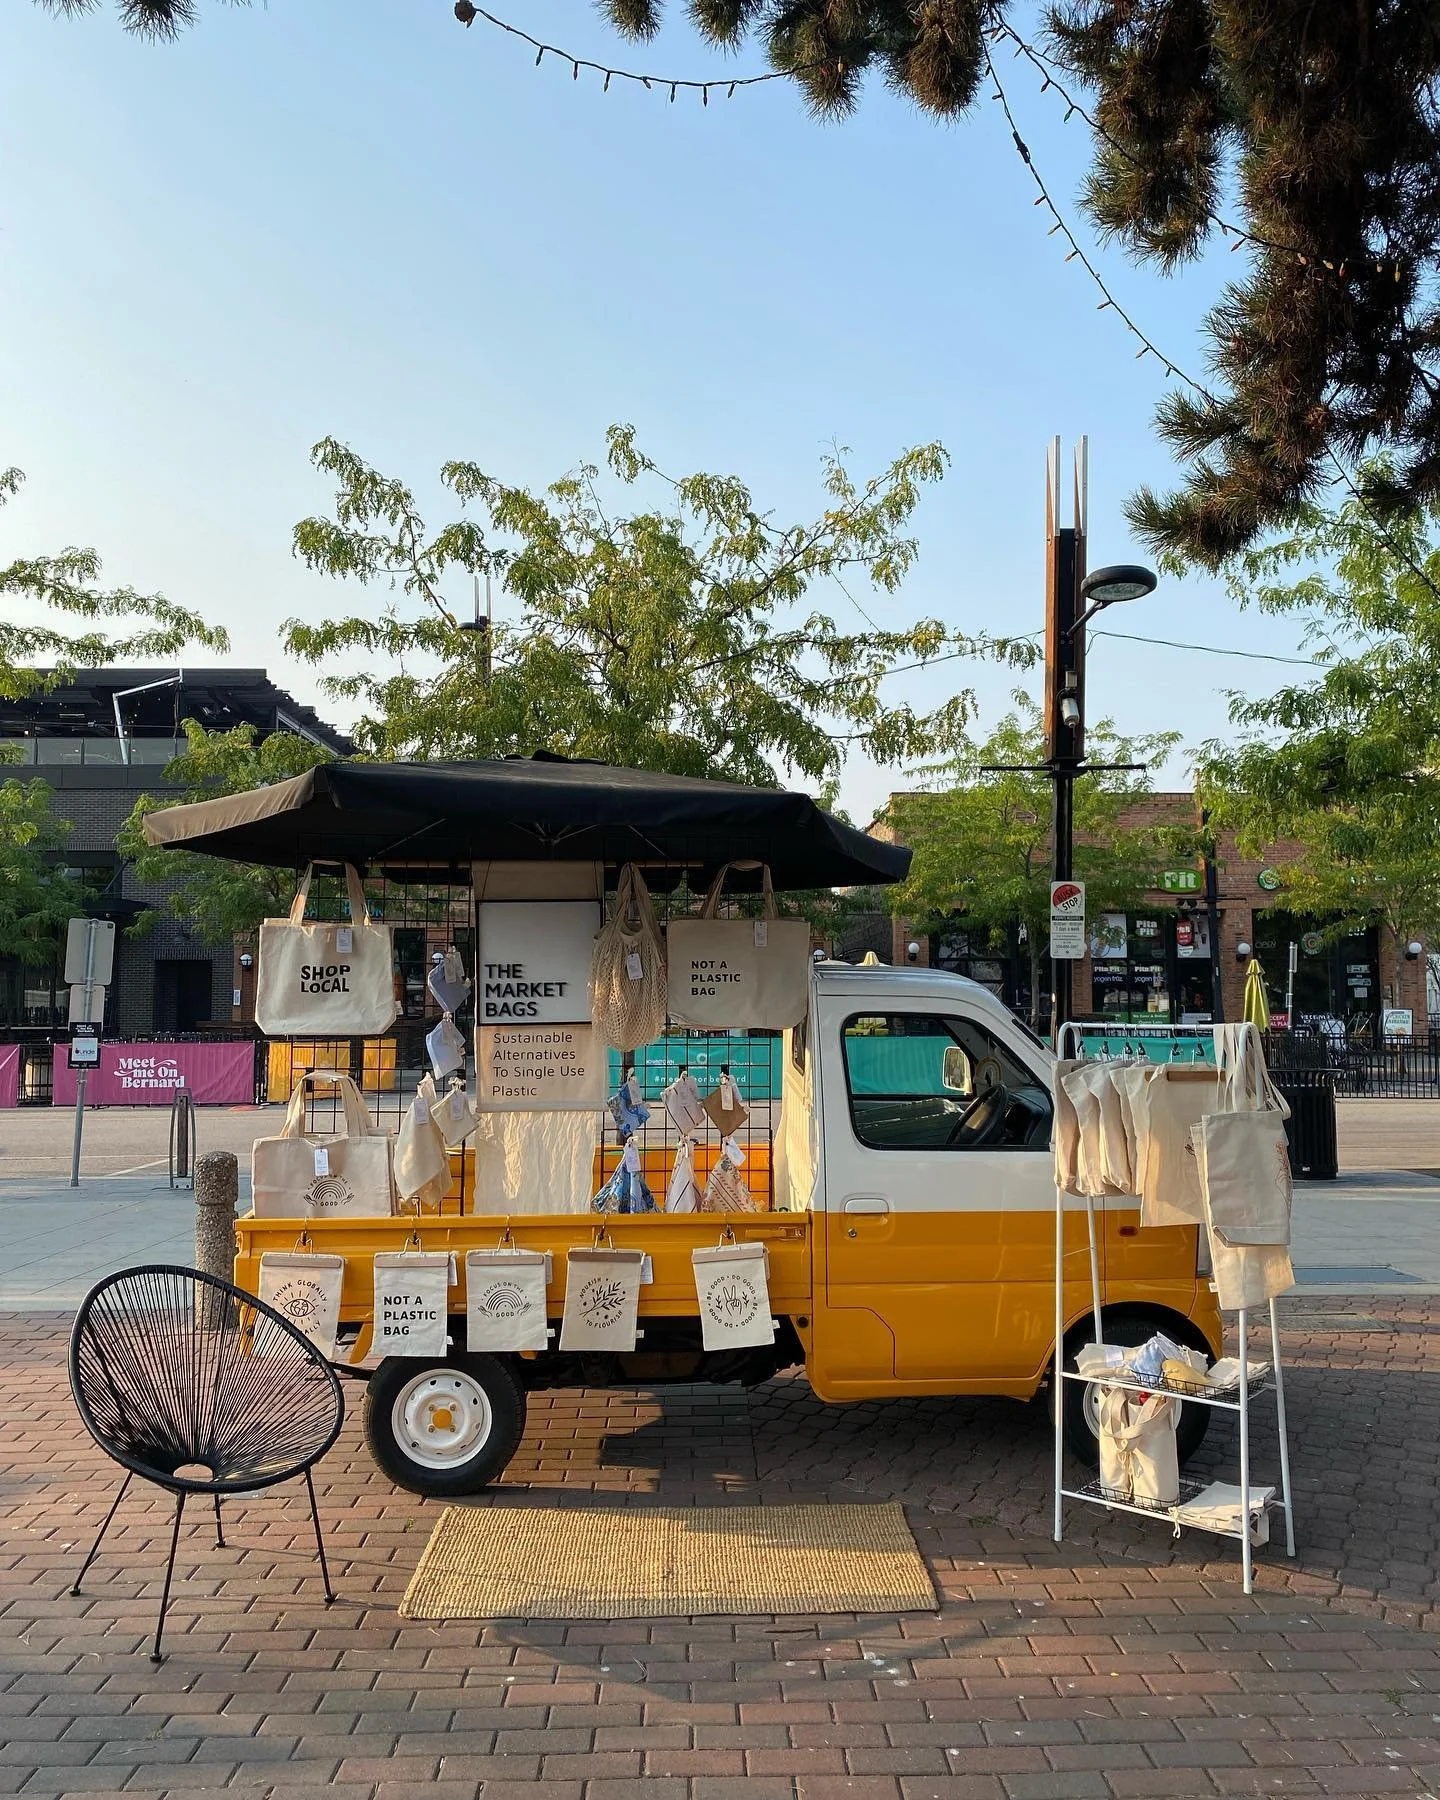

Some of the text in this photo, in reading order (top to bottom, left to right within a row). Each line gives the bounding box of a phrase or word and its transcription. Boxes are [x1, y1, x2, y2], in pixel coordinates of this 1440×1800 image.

[1164, 871, 1197, 888] Pit
[1062, 896, 1078, 911] STOP
[1136, 920, 1157, 928] Pita
[1140, 928, 1154, 936] Pit
[484, 963, 523, 979] THE
[691, 960, 728, 969] NOT A
[300, 964, 351, 981] SHOP
[691, 973, 741, 983] PLASTIC
[300, 977, 350, 994] LOCAL
[485, 982, 568, 998] MARKET
[691, 987, 716, 996] BAG
[485, 1001, 538, 1017] BAGS
[493, 1032, 573, 1044] Sustainable
[493, 1049, 576, 1061] Alternatives
[119, 1057, 170, 1070] Meet
[126, 1066, 178, 1078] me On
[493, 1065, 585, 1080] To Single Use
[121, 1075, 185, 1089] Bernard
[492, 1085, 538, 1097] Plastic
[272, 1279, 328, 1302] THINK GLOBALLY
[483, 1282, 501, 1297] FOCUS
[513, 1284, 524, 1294] THE
[579, 1277, 602, 1299] NOURISH
[383, 1295, 423, 1306] NOT A
[383, 1310, 437, 1321] PLASTIC
[585, 1310, 623, 1329] TO FLOURISH
[304, 1320, 321, 1335] ALLY
[383, 1325, 410, 1336] BAG
